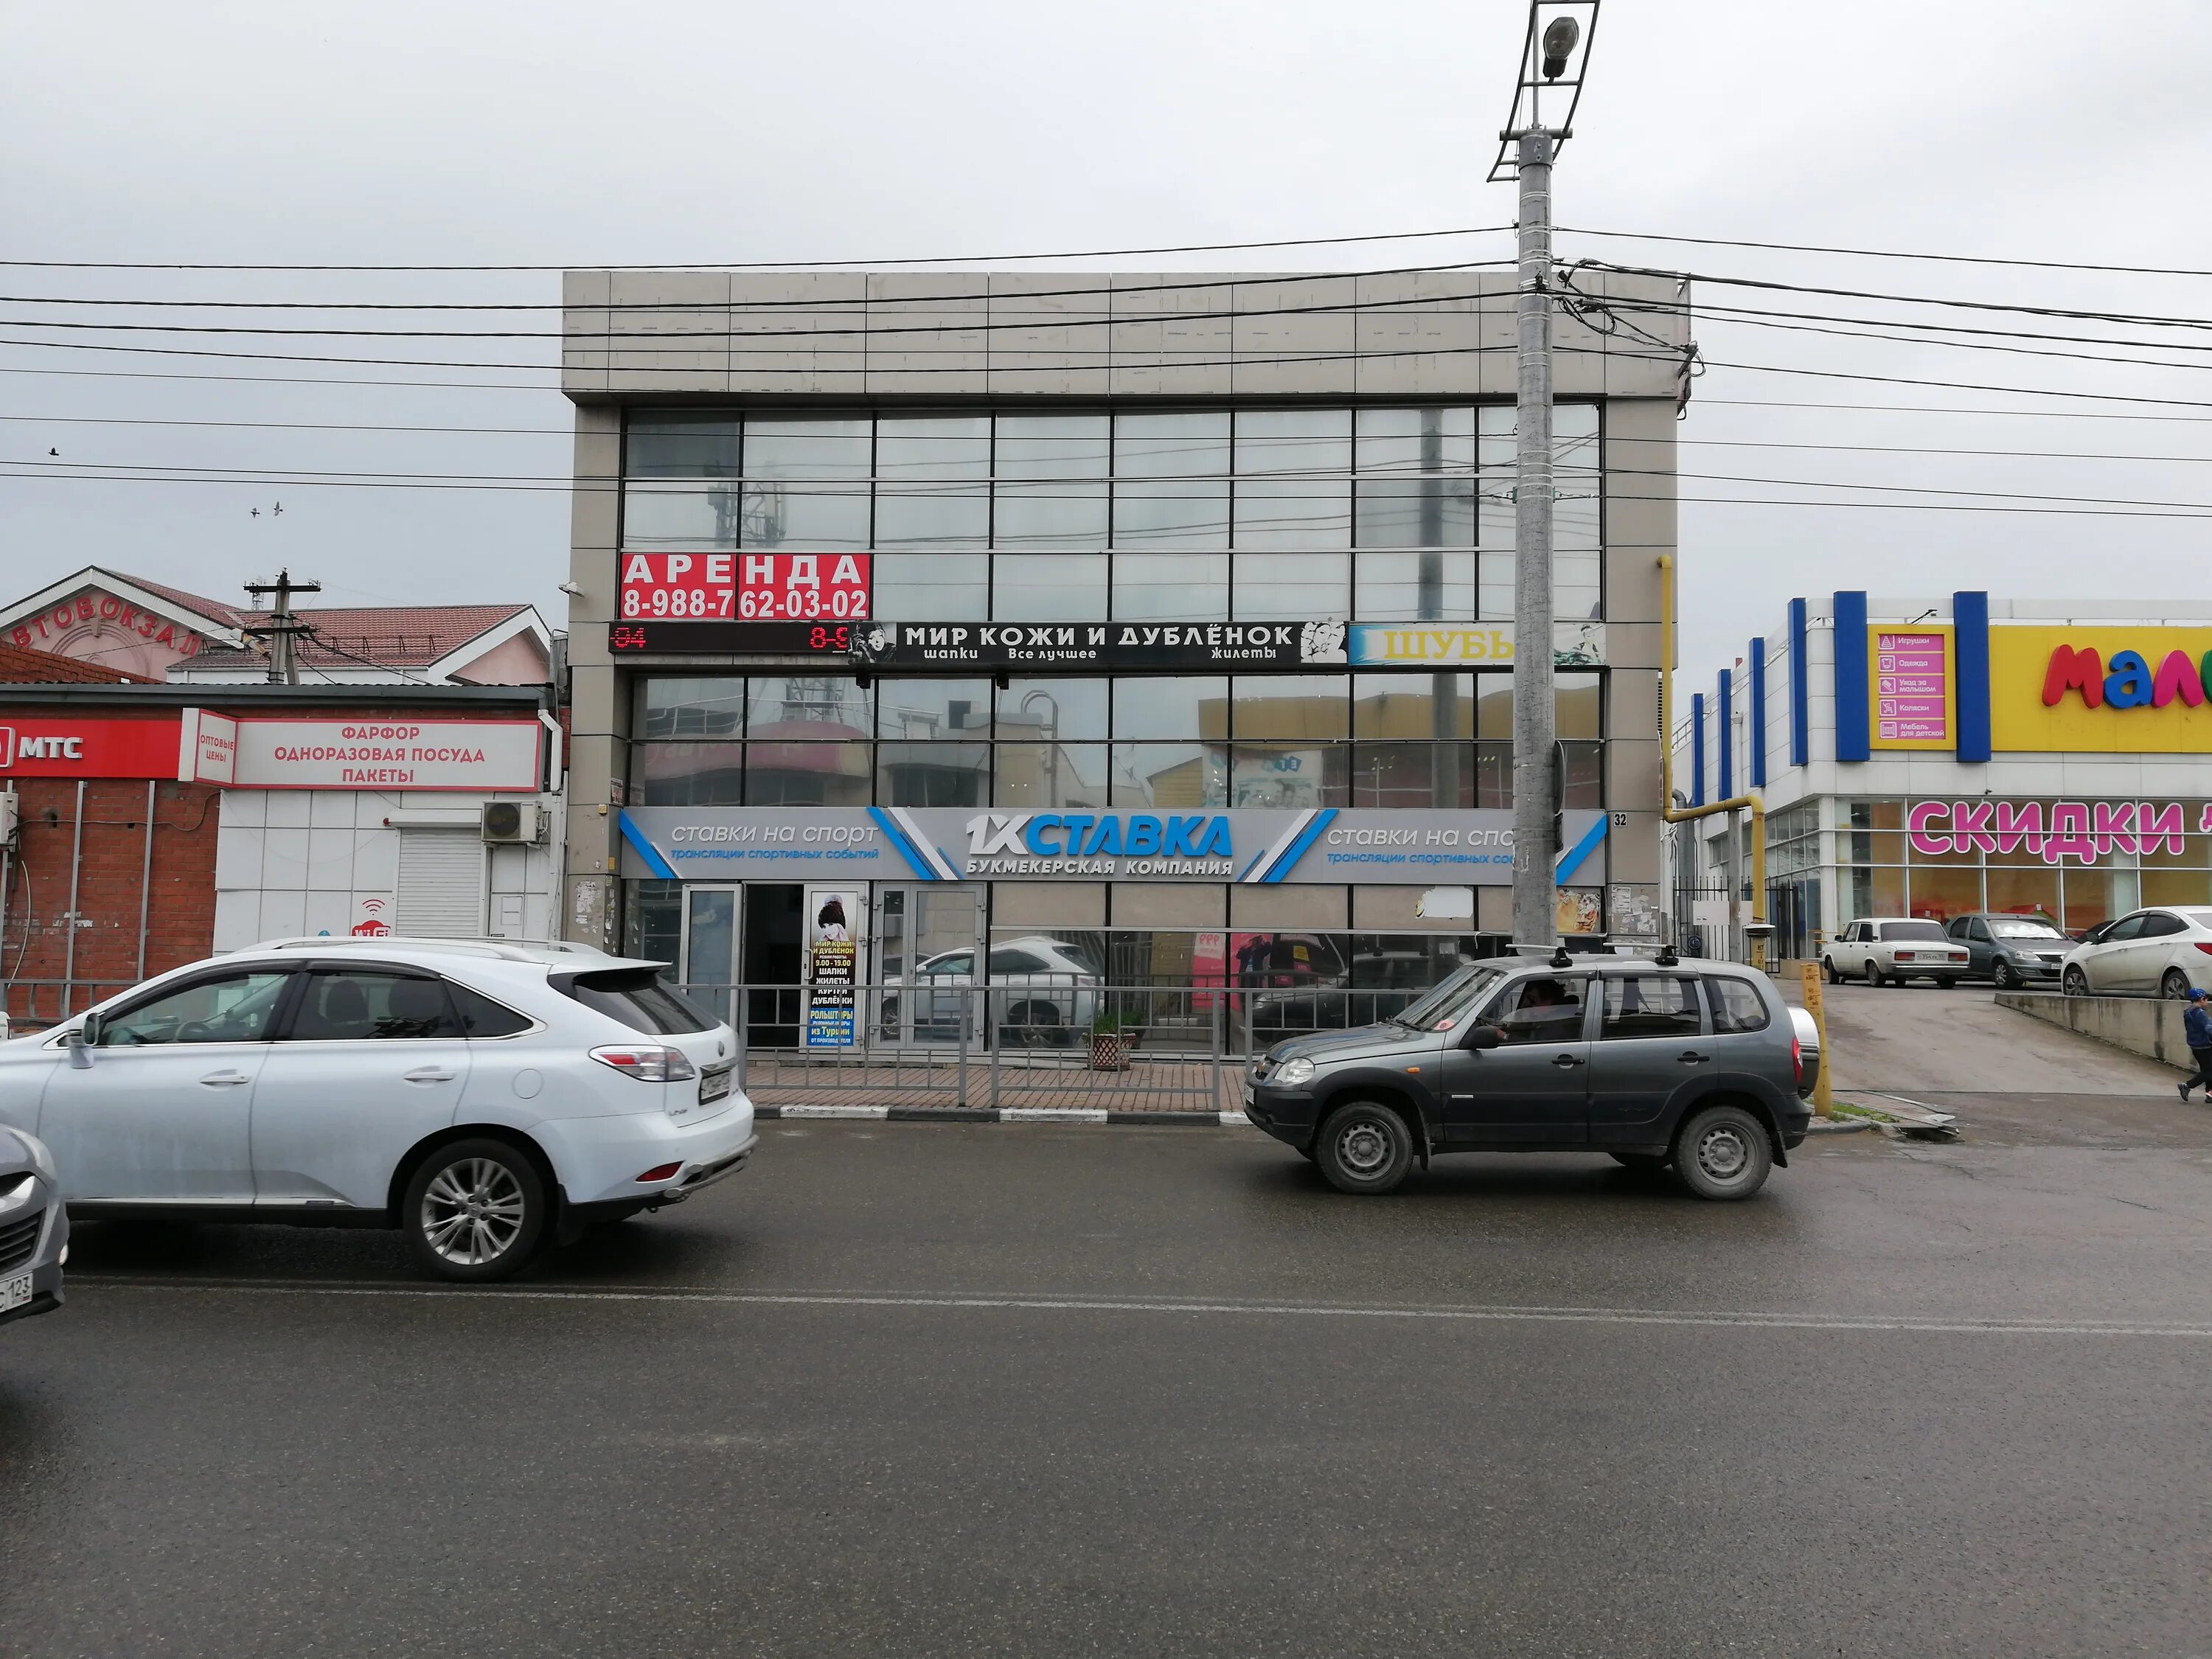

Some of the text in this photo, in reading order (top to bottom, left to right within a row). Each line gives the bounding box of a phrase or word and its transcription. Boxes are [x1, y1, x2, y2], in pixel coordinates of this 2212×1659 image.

[624, 554, 861, 590] АРЕНДА
[624, 589, 866, 617] 8-988-762-03-02
[10, 595, 203, 656] ВТОВОКЗАЛ
[905, 624, 1293, 646] МИР КОЖИ И ДУБЛЁНОК
[924, 646, 1277, 661] шапки Все лучшее жилеты
[341, 726, 420, 740] ФАРФОР
[18, 737, 83, 759] МТС
[200, 734, 234, 751] ОПТОВЫЕ
[206, 749, 227, 763] ЦЕНЫ
[274, 747, 485, 763] ОДНОРАЗОВАЯ ПОСУДА
[342, 768, 414, 782] ПАКЕТЫ
[1615, 814, 1627, 826] 32
[671, 826, 880, 847] ставки на спорт
[1327, 828, 1514, 847] ставки на спо
[1908, 801, 2185, 865] СКИДКИ
[671, 848, 879, 861] трансляции спортивных событий
[1327, 852, 1405, 864] трансляции
[1409, 853, 1489, 866] спортивных
[966, 860, 1234, 875] БУКМЕКЕРСКАЯ КОМПАНИЯ
[8, 1276, 30, 1298] 123
